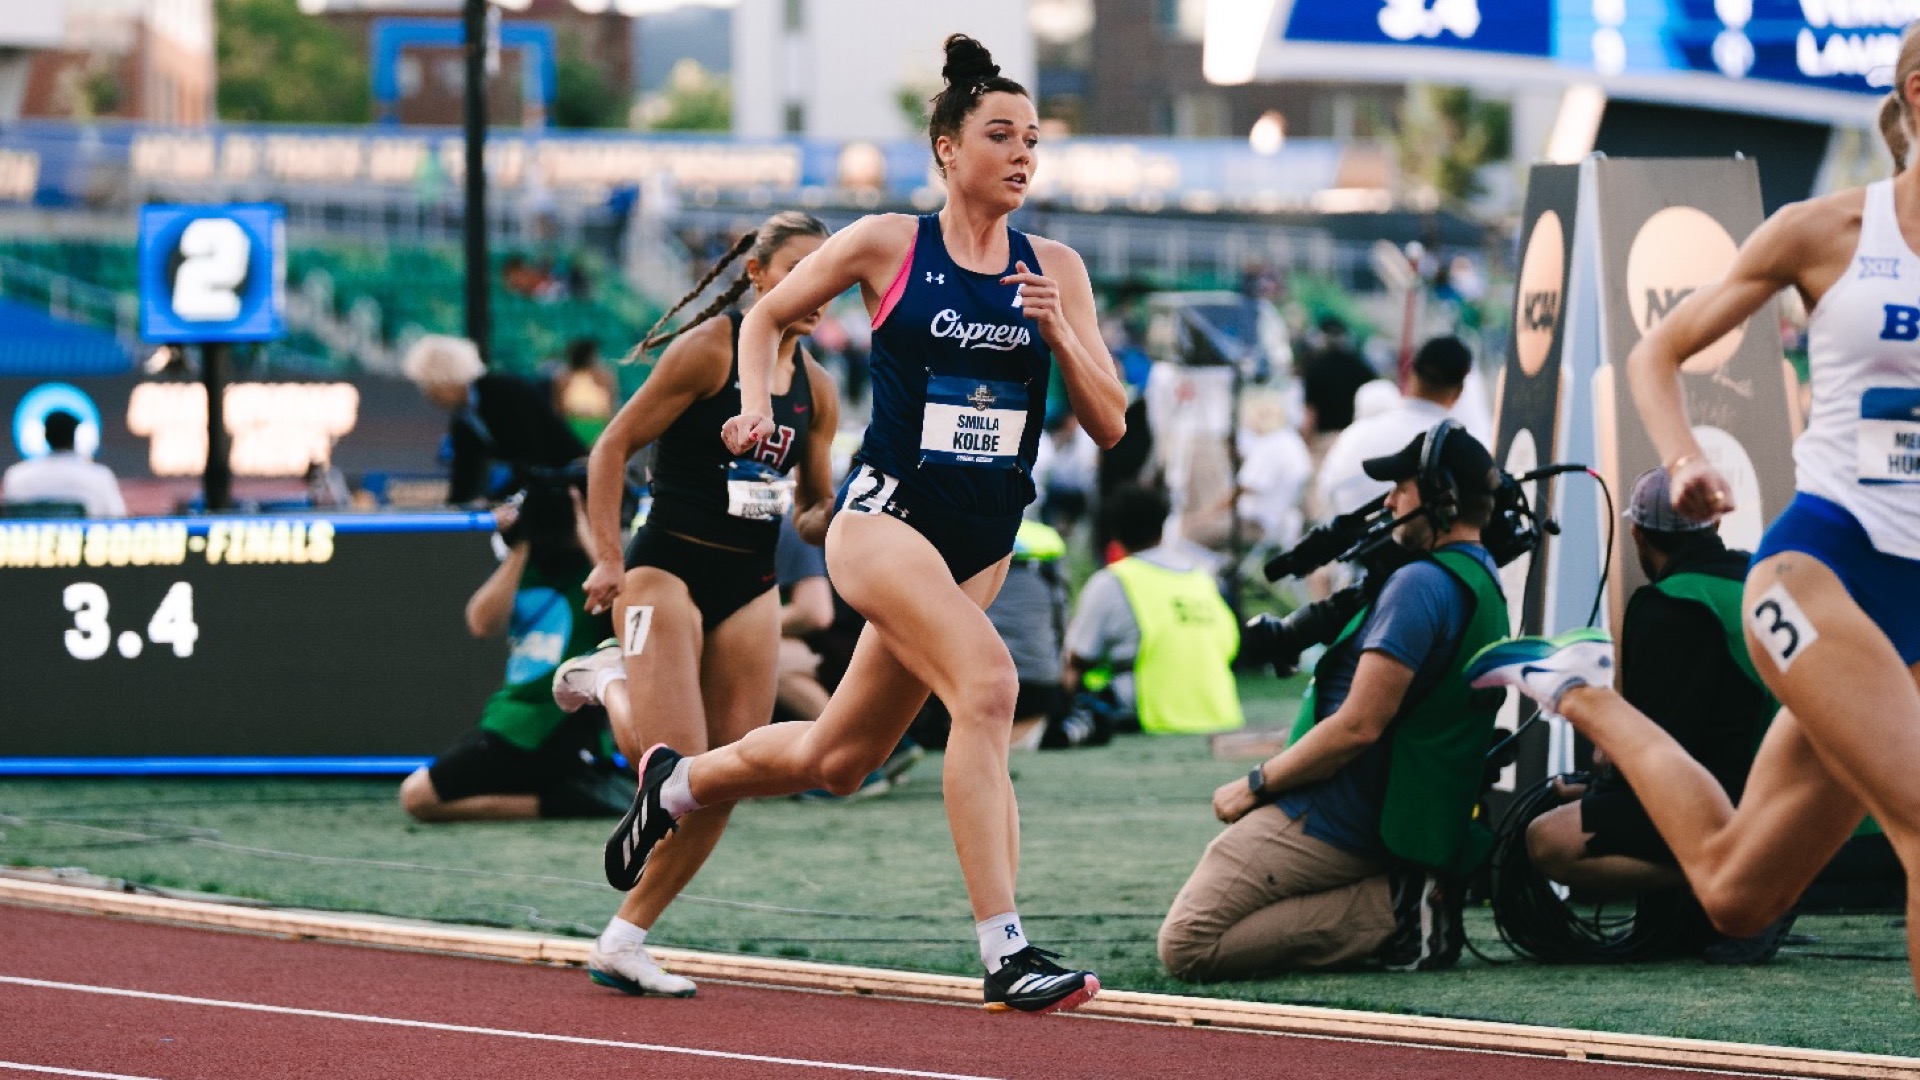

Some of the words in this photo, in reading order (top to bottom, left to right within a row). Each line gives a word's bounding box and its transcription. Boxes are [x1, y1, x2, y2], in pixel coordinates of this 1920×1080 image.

[172, 218, 250, 321] 2
[931, 308, 1031, 351] Ospreys
[1879, 303, 1920, 341] B
[953, 432, 1000, 452] KOLBE
[957, 414, 999, 430] SMILLA
[849, 468, 886, 512] 2
[63, 581, 198, 660] 3.4
[1755, 600, 1798, 659] 3
